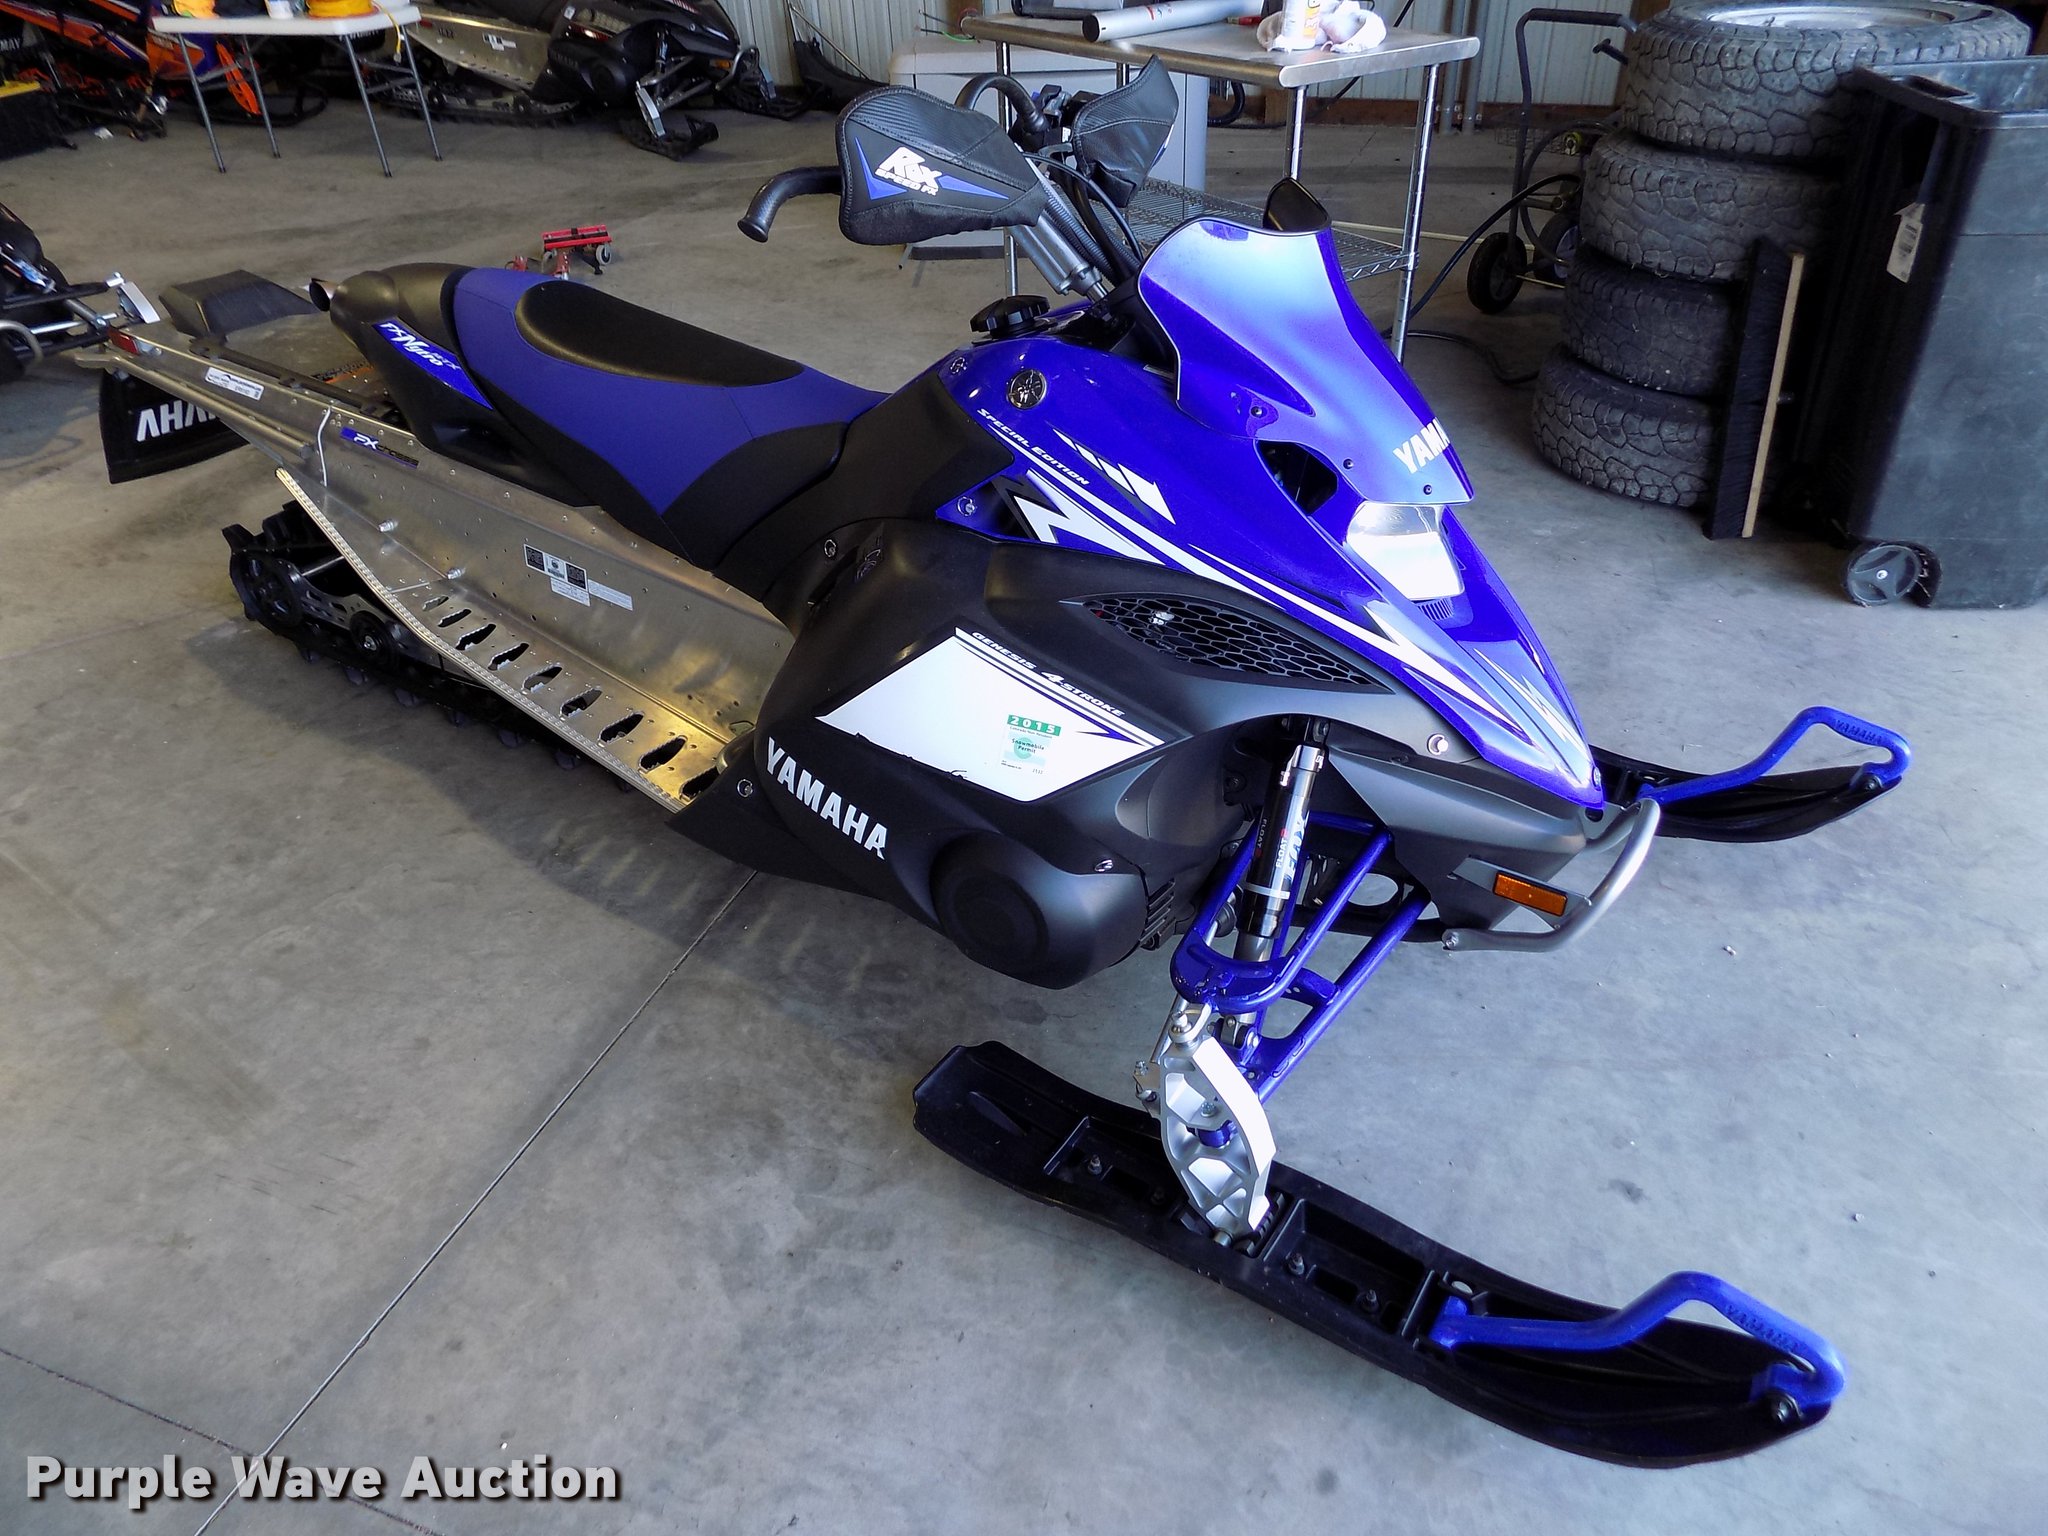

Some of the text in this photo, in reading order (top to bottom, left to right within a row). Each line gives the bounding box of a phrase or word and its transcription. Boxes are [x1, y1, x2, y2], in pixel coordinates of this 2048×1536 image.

[380, 322, 409, 337] FX
[353, 432, 379, 450] FX
[977, 408, 1090, 485] SPECIAL EDITION
[971, 632, 1037, 670] GENESIS
[1009, 715, 1056, 734] 2015
[1011, 738, 1045, 751] Snowmobile
[1017, 745, 1037, 755] Permit
[766, 736, 888, 861] YAMAHA
[1256, 818, 1268, 850] FLOAT
[1275, 836, 1290, 869] FLOAT
